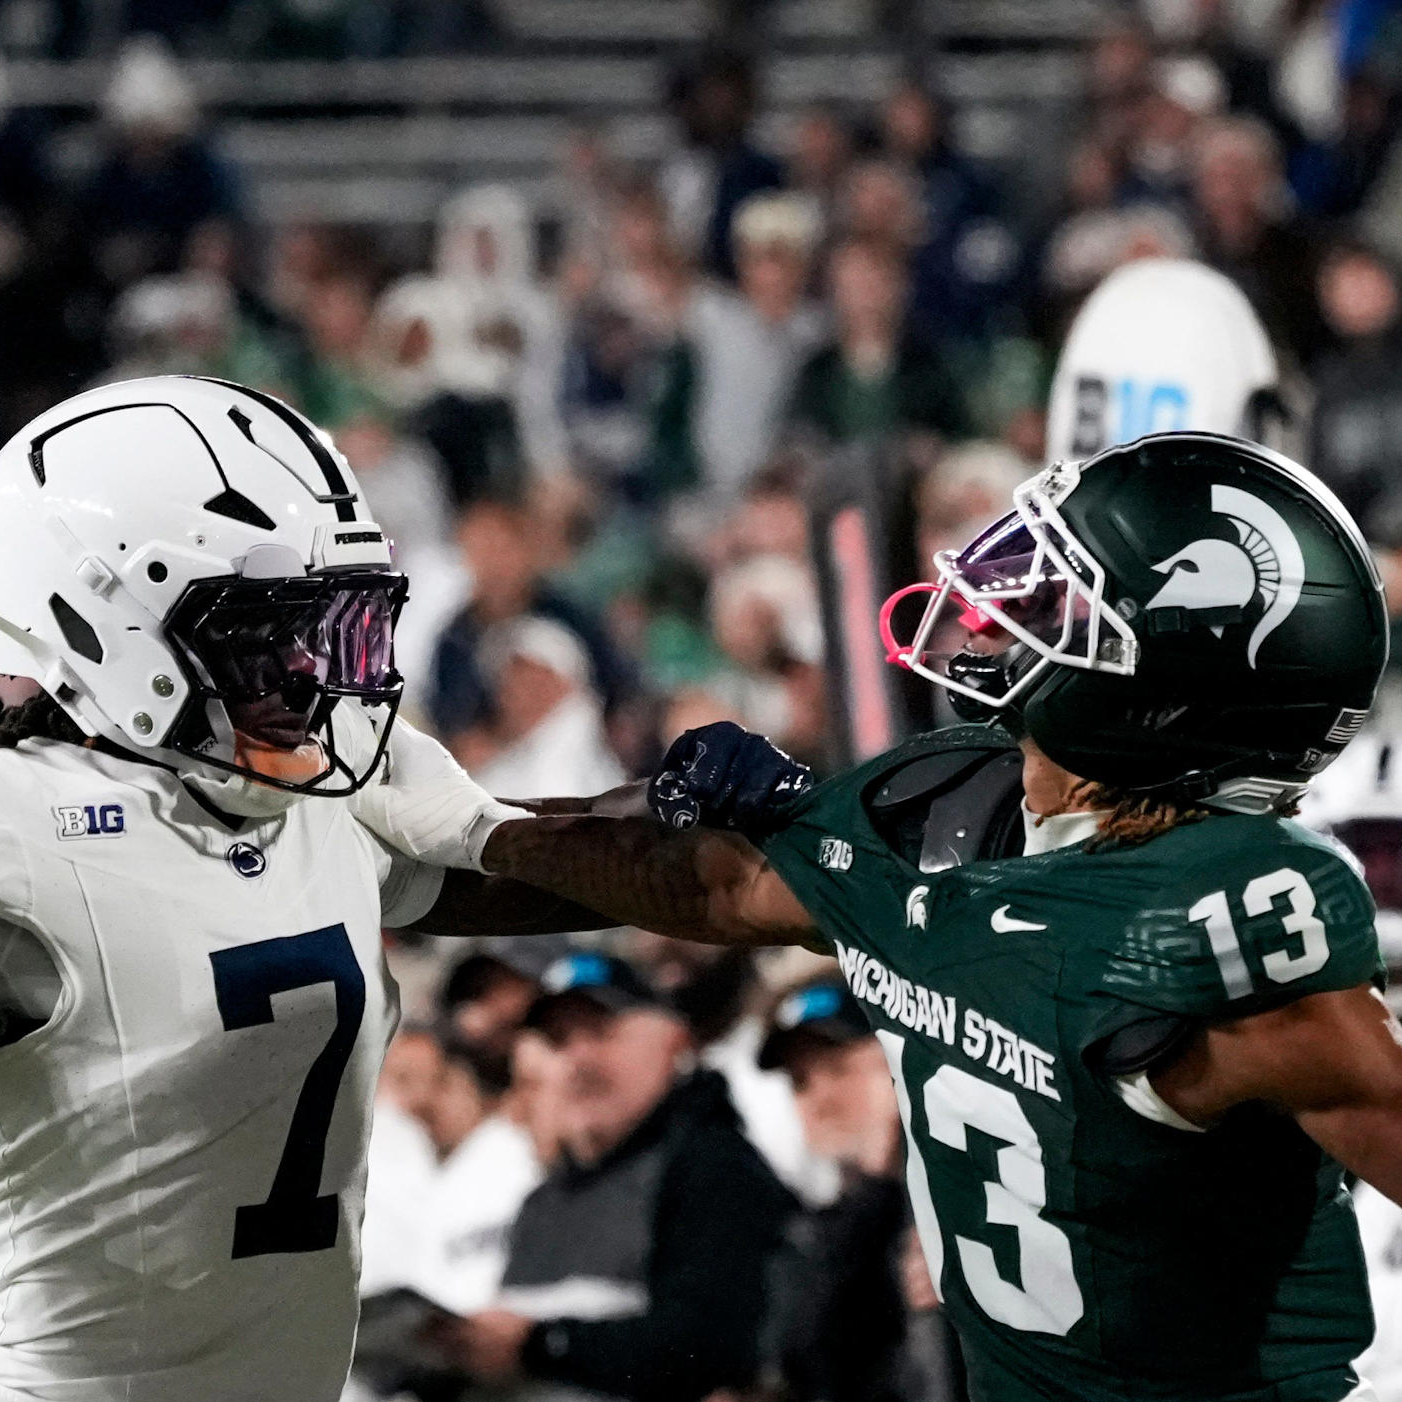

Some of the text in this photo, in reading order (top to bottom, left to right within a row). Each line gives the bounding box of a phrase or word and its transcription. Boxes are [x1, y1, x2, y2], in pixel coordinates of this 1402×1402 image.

[59, 805, 125, 837] B1G
[1188, 867, 1330, 1000] 13
[209, 922, 366, 1260] 7
[834, 938, 1062, 1102] MICHIGAN STATE
[875, 1028, 1085, 1337] 13
